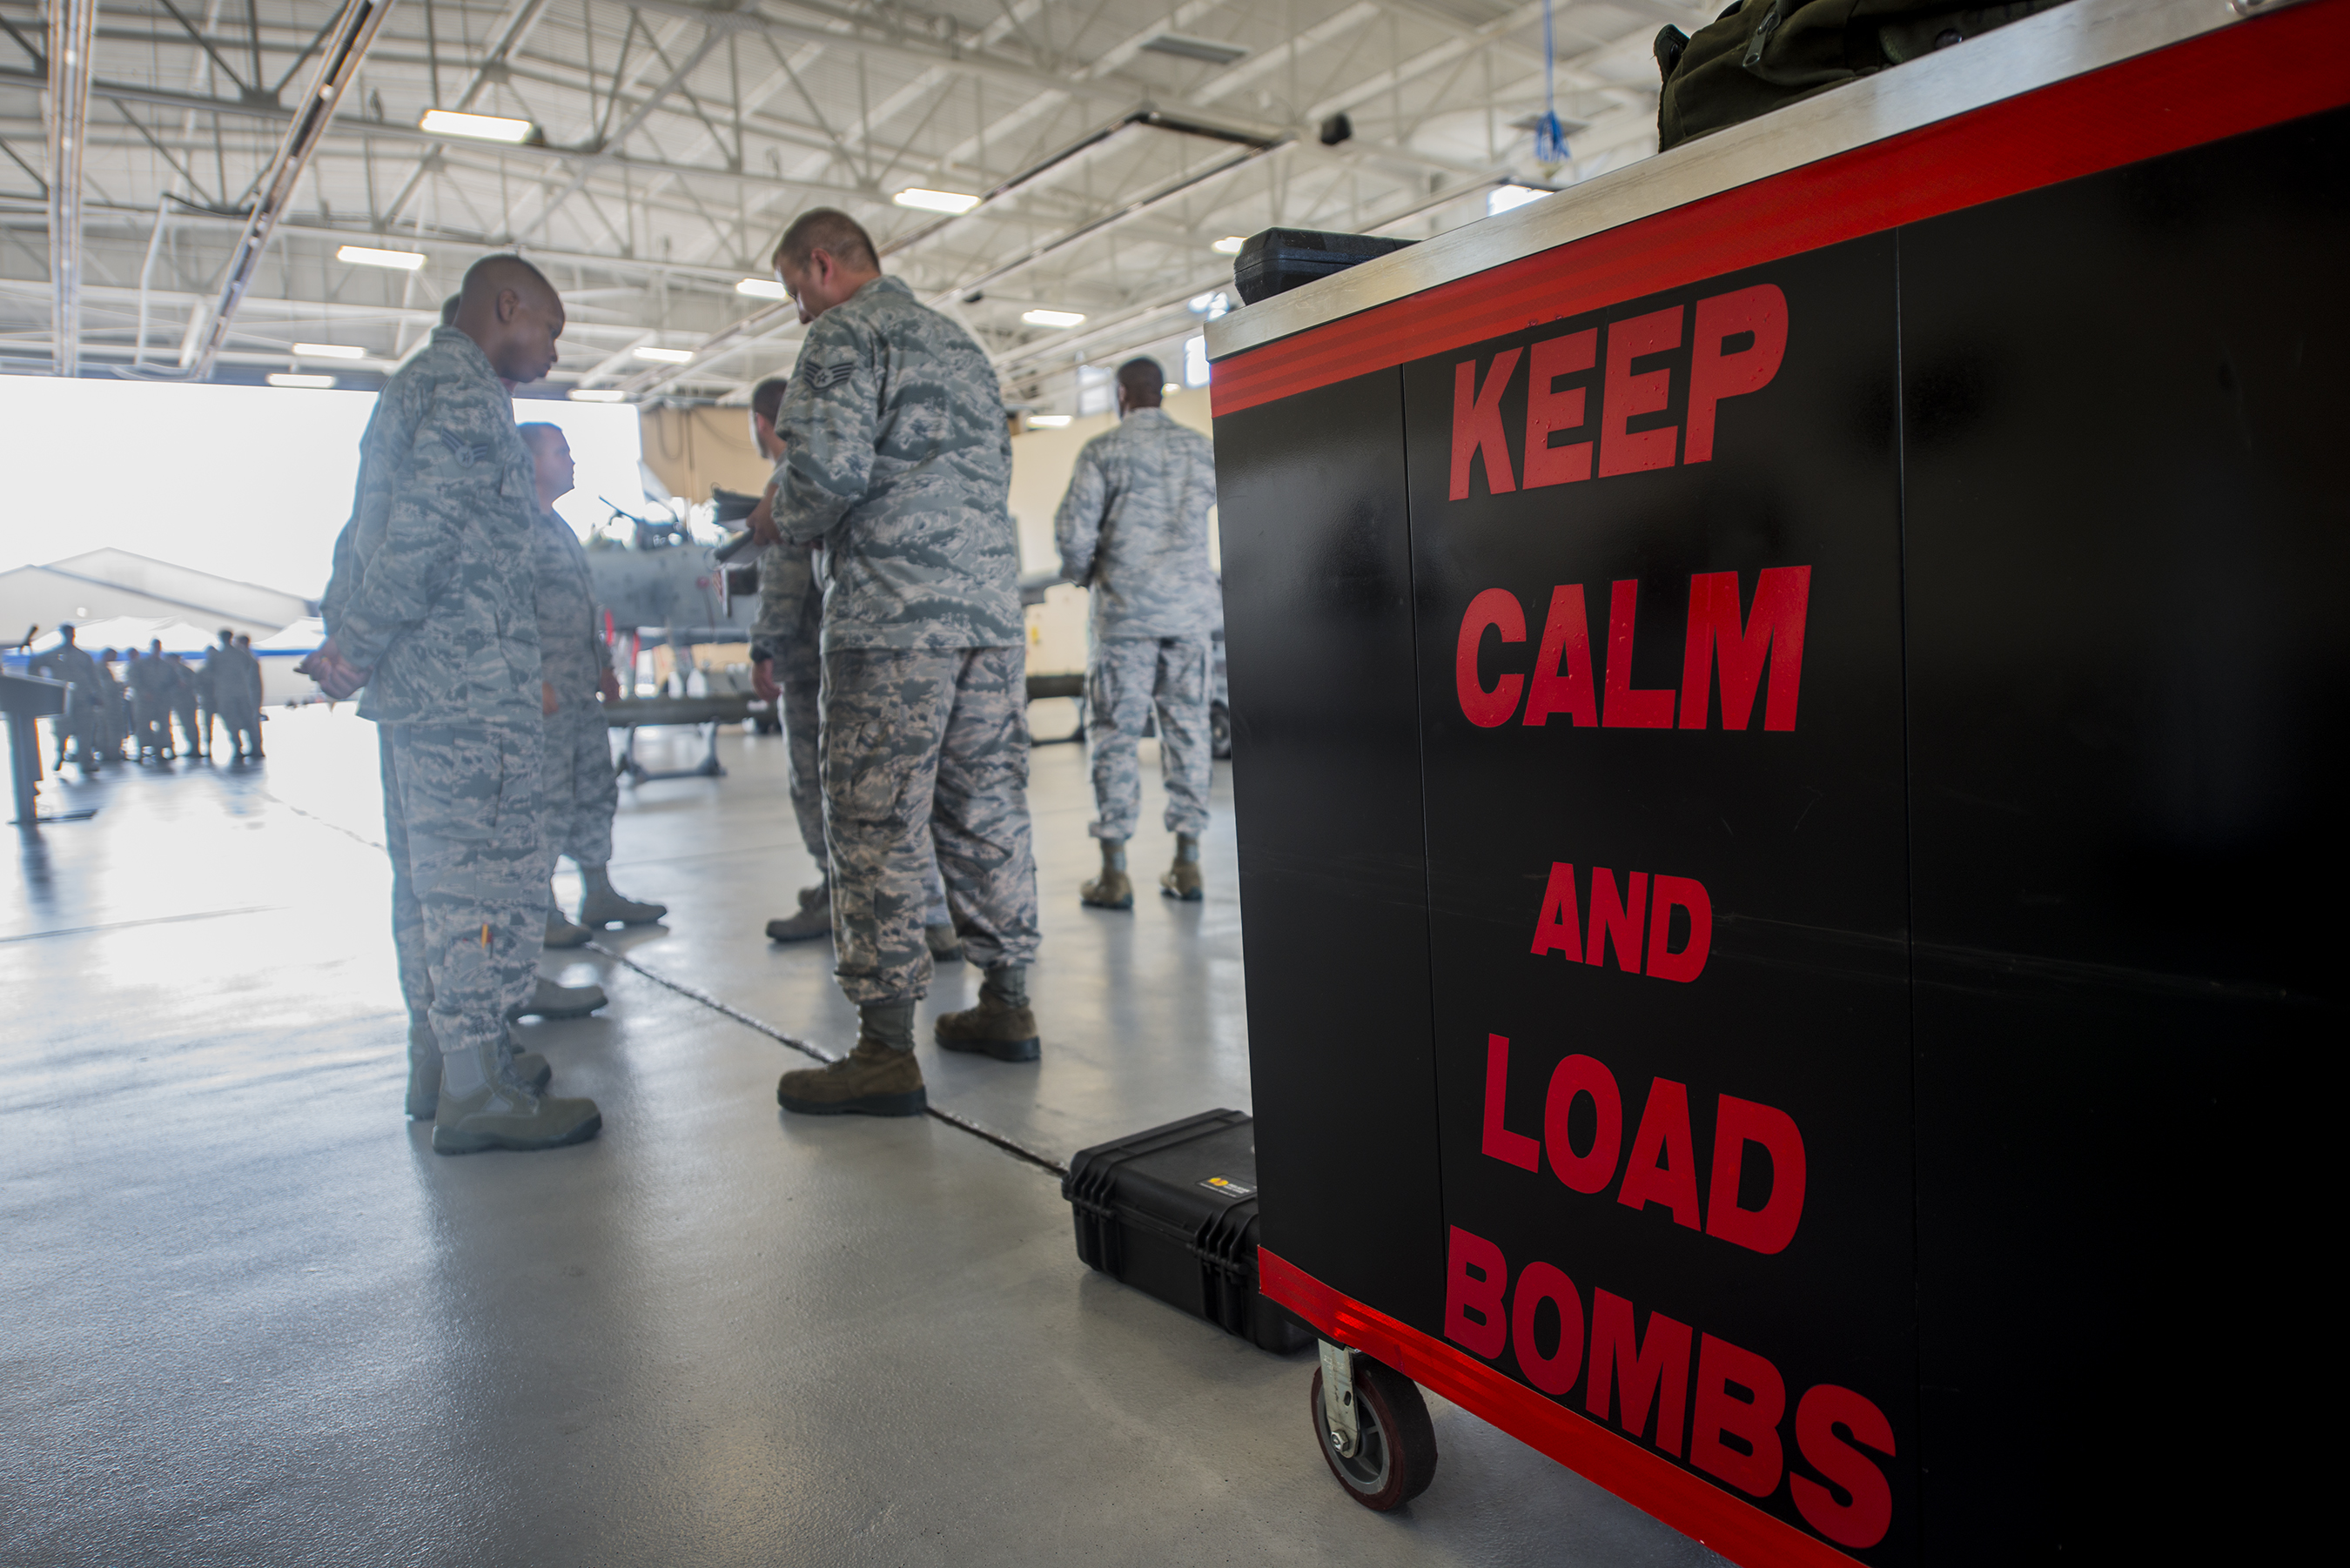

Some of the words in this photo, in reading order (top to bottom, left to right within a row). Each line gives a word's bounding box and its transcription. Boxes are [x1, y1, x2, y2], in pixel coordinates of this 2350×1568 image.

[1449, 284, 1788, 501] KEEP
[1456, 566, 1811, 732] CALM
[1530, 861, 1712, 983] AND
[1481, 1033, 1807, 1255] LOAD
[1444, 1224, 1896, 1548] BOMBS
